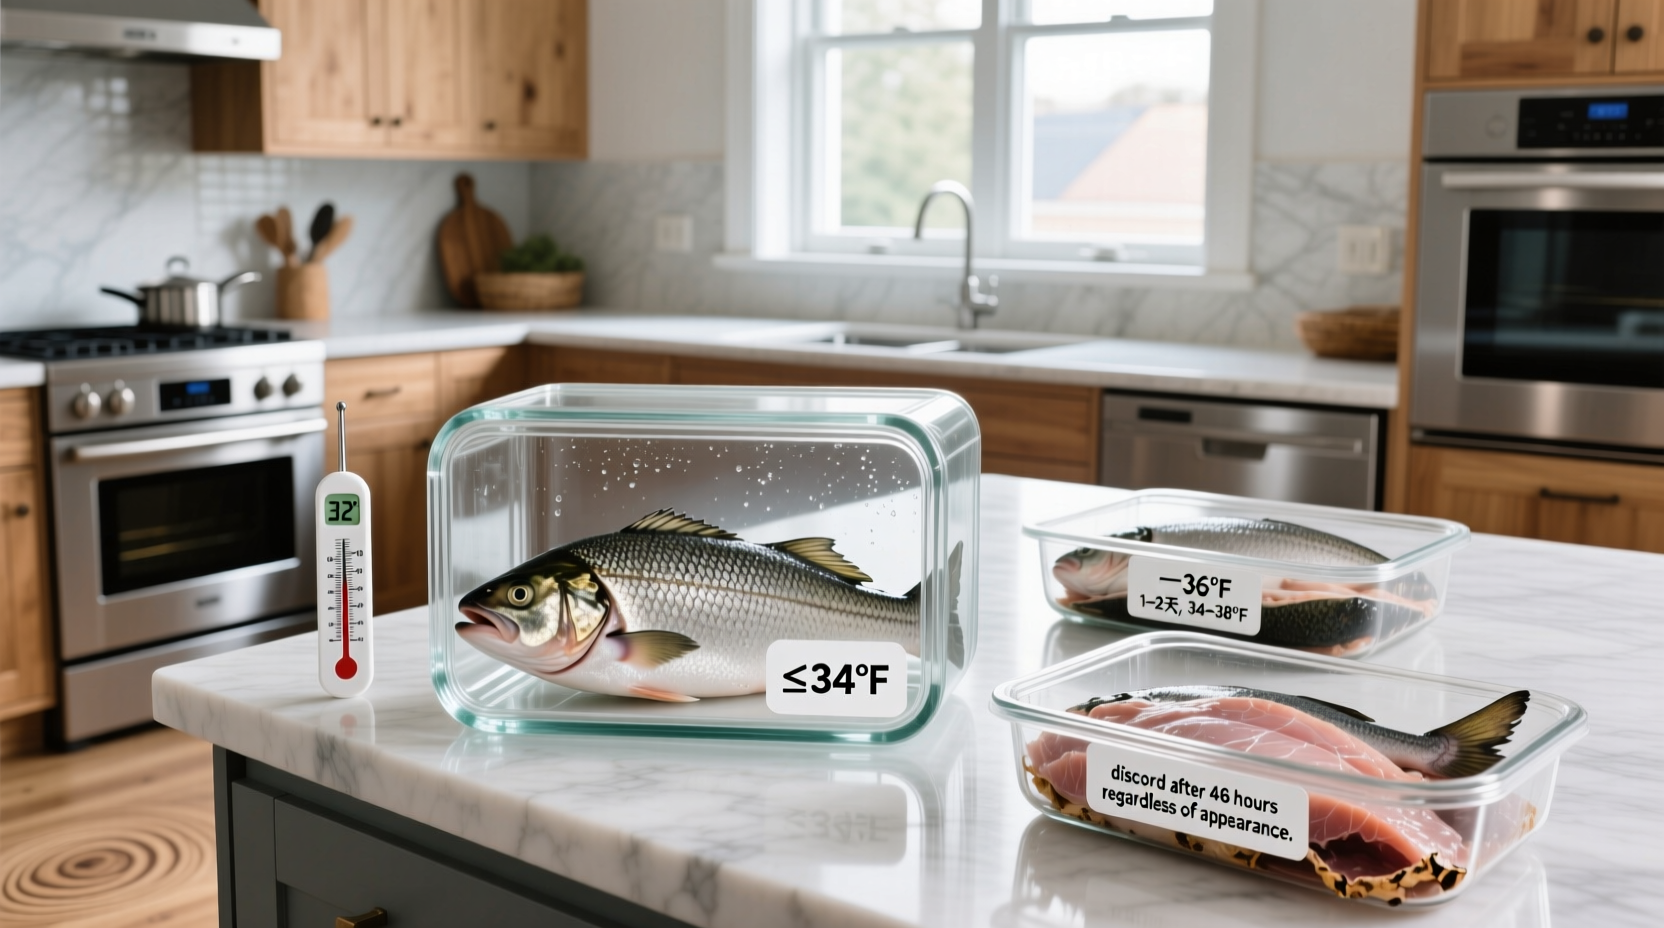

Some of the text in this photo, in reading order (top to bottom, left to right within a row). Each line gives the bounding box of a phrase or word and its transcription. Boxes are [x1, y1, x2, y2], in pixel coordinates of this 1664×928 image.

[782, 663, 889, 695] ≤34°F
[1111, 764, 1278, 814] discord after 46 hours
[1102, 787, 1293, 842] regardless of appearance.
